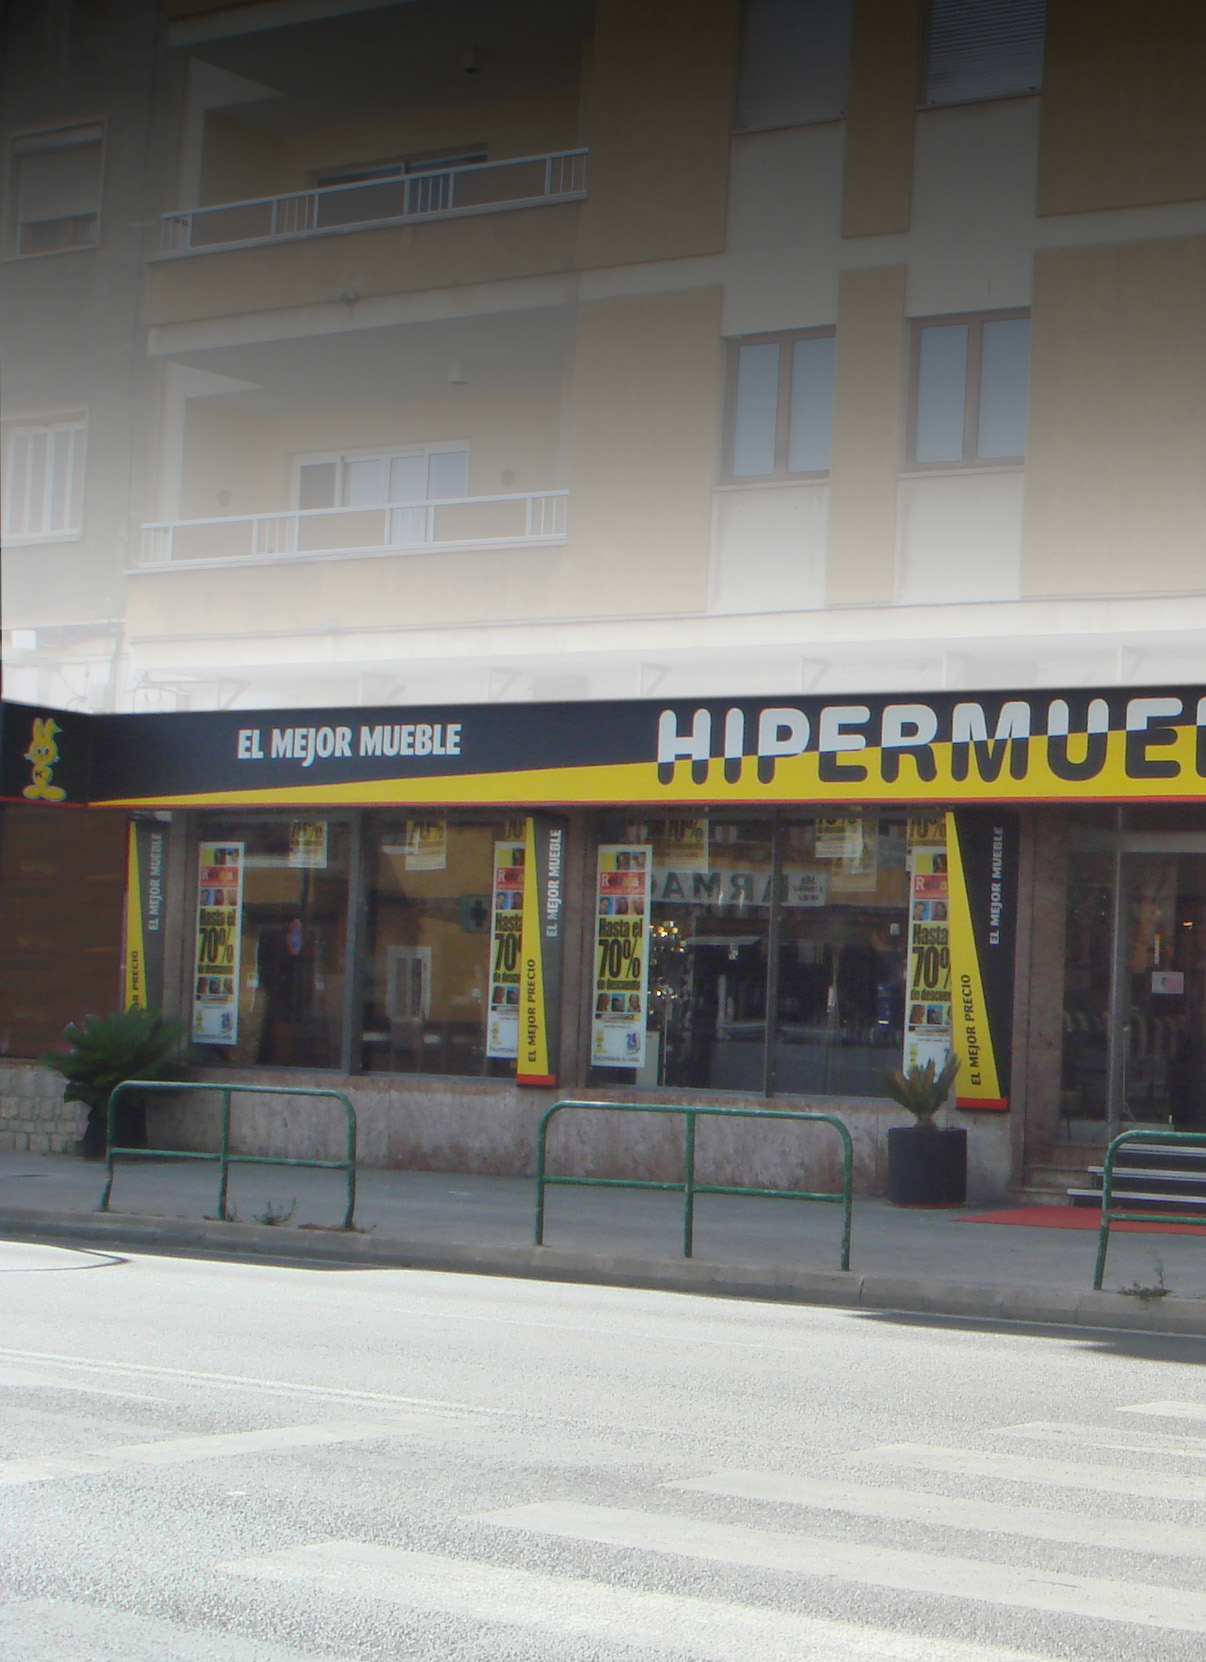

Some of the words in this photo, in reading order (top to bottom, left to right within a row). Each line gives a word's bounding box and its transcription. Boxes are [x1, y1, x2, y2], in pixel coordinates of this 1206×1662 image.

[237, 729, 264, 759] EL
[271, 726, 352, 767] MEJOR
[360, 723, 462, 757] MUEBLE
[150, 834, 162, 880] MUEBLE
[548, 829, 562, 879] MUEBLE
[992, 827, 1003, 880] MUEBLE
[149, 881, 163, 917] MEJOR
[547, 880, 562, 922] MEJOR
[990, 882, 1003, 930] MEJOR
[149, 918, 158, 931] EL
[546, 924, 557, 937] EL
[599, 918, 630, 938] Hasta
[632, 918, 642, 938] el
[912, 924, 948, 945] Hasta
[990, 931, 999, 945] EL
[200, 927, 234, 963] 70%
[495, 933, 522, 971] 70
[598, 938, 640, 978] 70%
[528, 959, 536, 1003] PRECIO
[961, 974, 974, 1021] PRECIO
[528, 1007, 539, 1046] MEJOR
[970, 1024, 981, 1066] MEJOR
[528, 1050, 536, 1062] EL
[971, 1073, 981, 1086] EL
